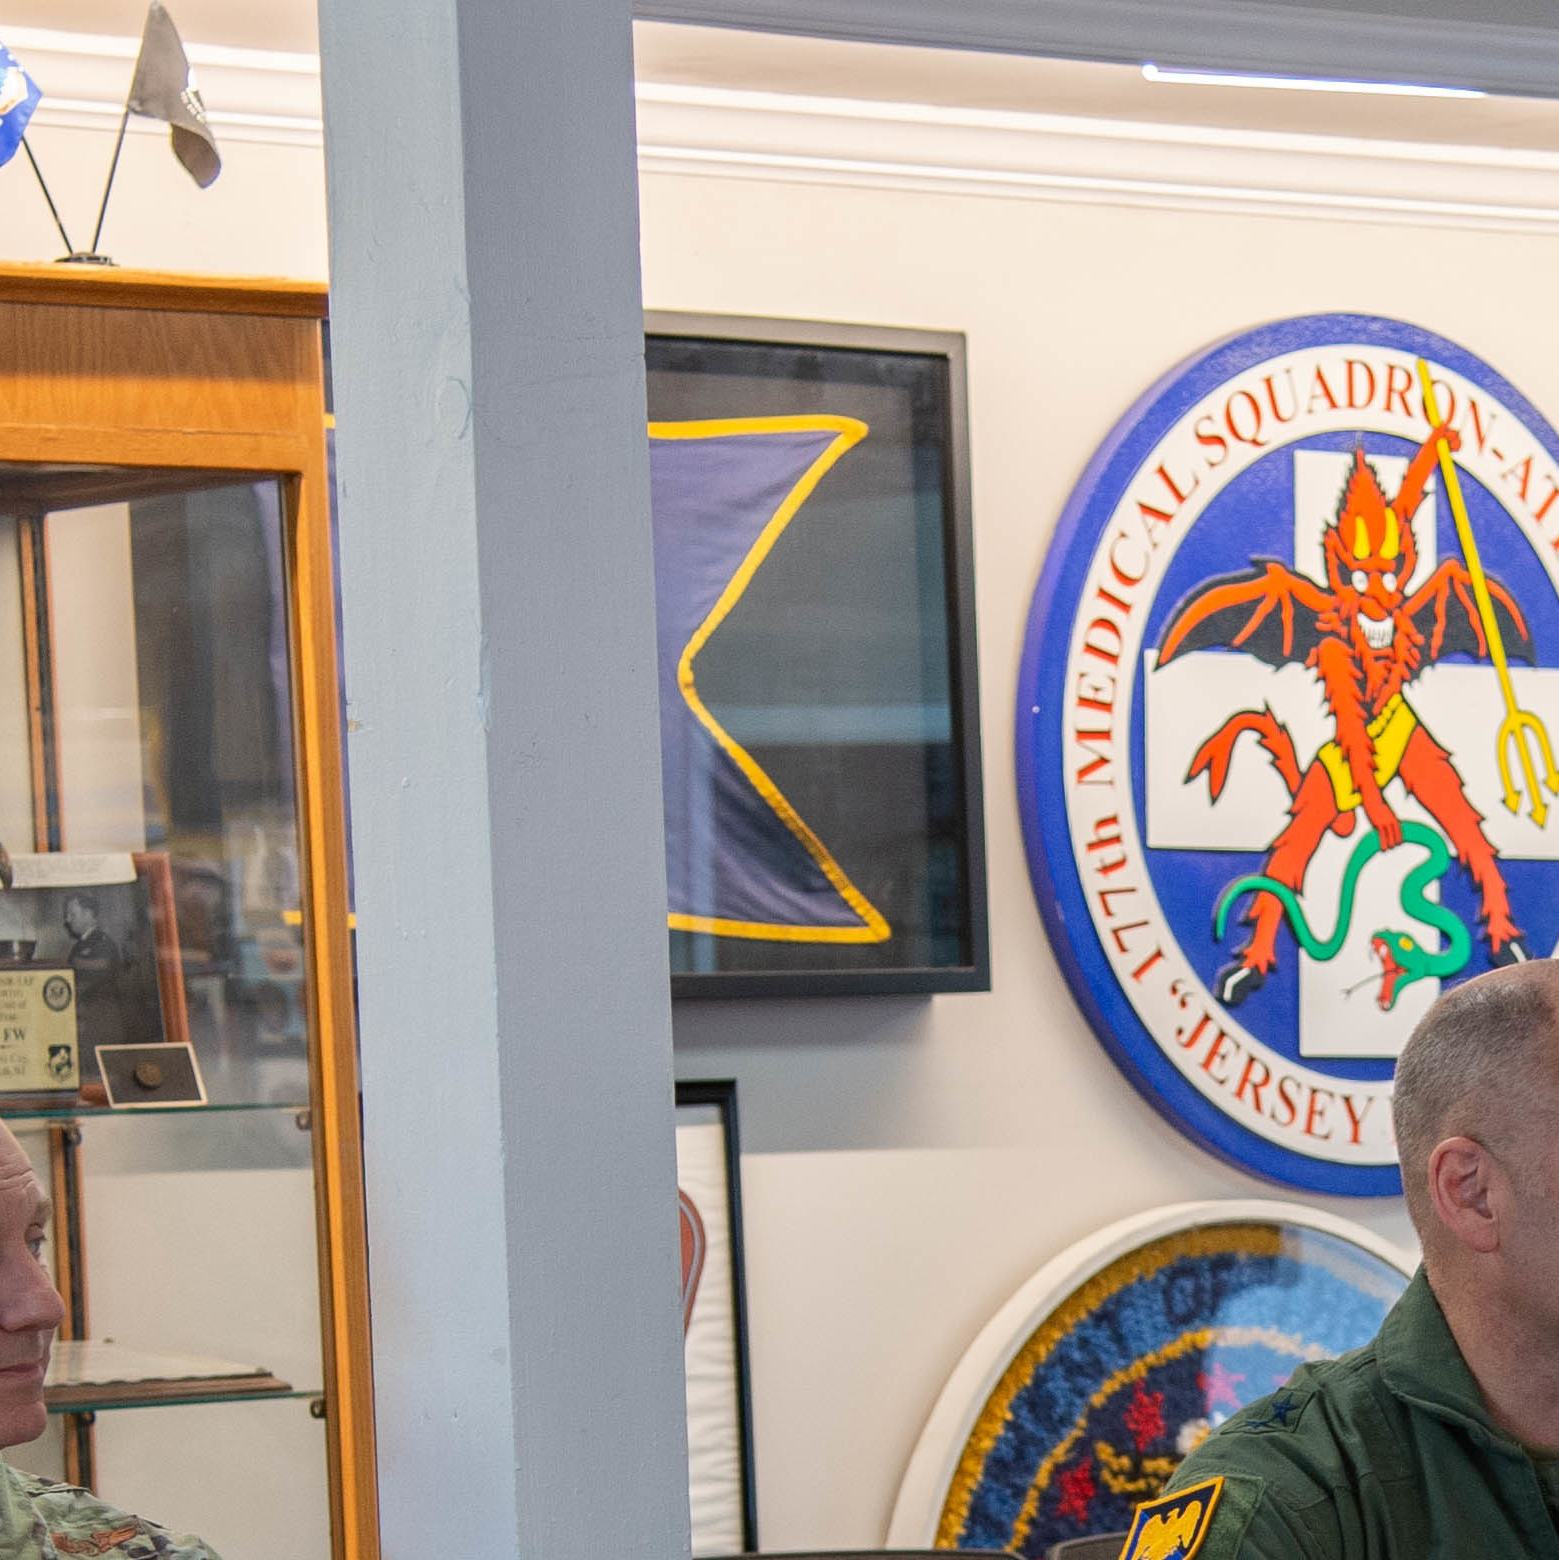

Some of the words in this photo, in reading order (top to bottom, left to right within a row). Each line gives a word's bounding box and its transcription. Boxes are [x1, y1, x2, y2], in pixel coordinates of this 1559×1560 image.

[1076, 461, 1201, 792] MEDICAL
[1083, 812, 1167, 985] 177th
[3, 1027, 27, 1042] FW
